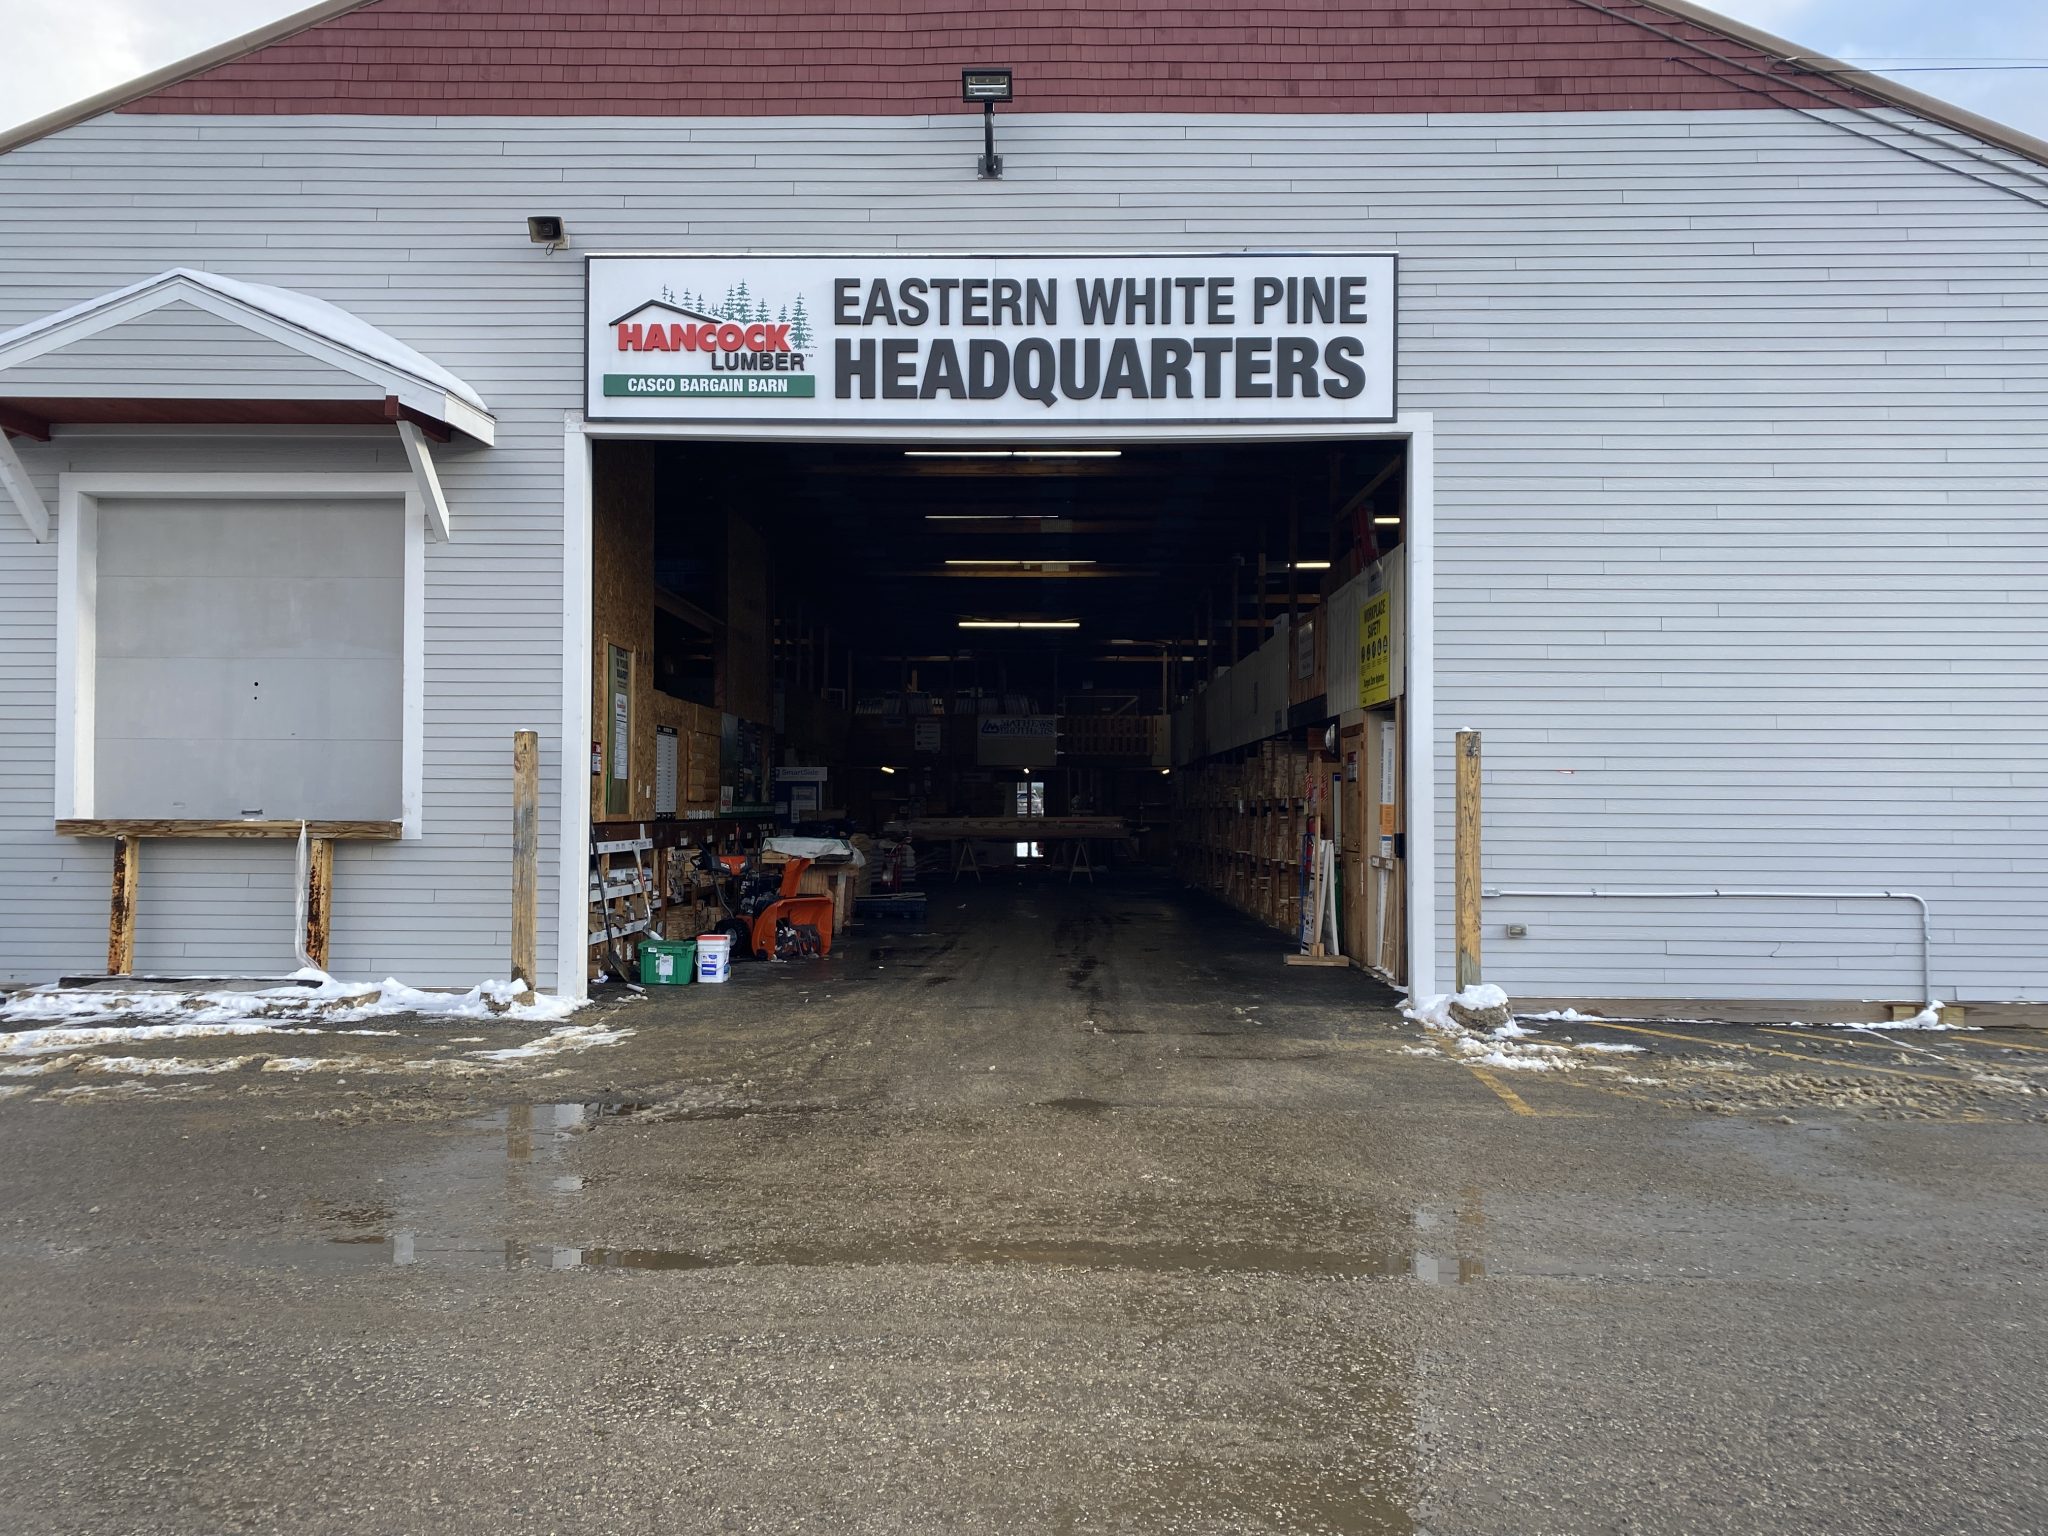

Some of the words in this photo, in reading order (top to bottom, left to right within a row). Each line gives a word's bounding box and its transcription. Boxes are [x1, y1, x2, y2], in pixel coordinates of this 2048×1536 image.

[834, 277, 1058, 326] EASTERN
[1075, 277, 1235, 325] WHITE
[1253, 276, 1368, 325] PINE
[618, 323, 791, 352] HANCOCK
[711, 352, 805, 371] LUMBER
[834, 336, 1366, 408] HEADQUARTERS
[627, 377, 675, 392] CASCO
[680, 378, 743, 392] BARGAIN
[748, 378, 788, 392] BARN
[1364, 598, 1386, 624] WORKPLACE
[1367, 620, 1381, 640] SAFETY
